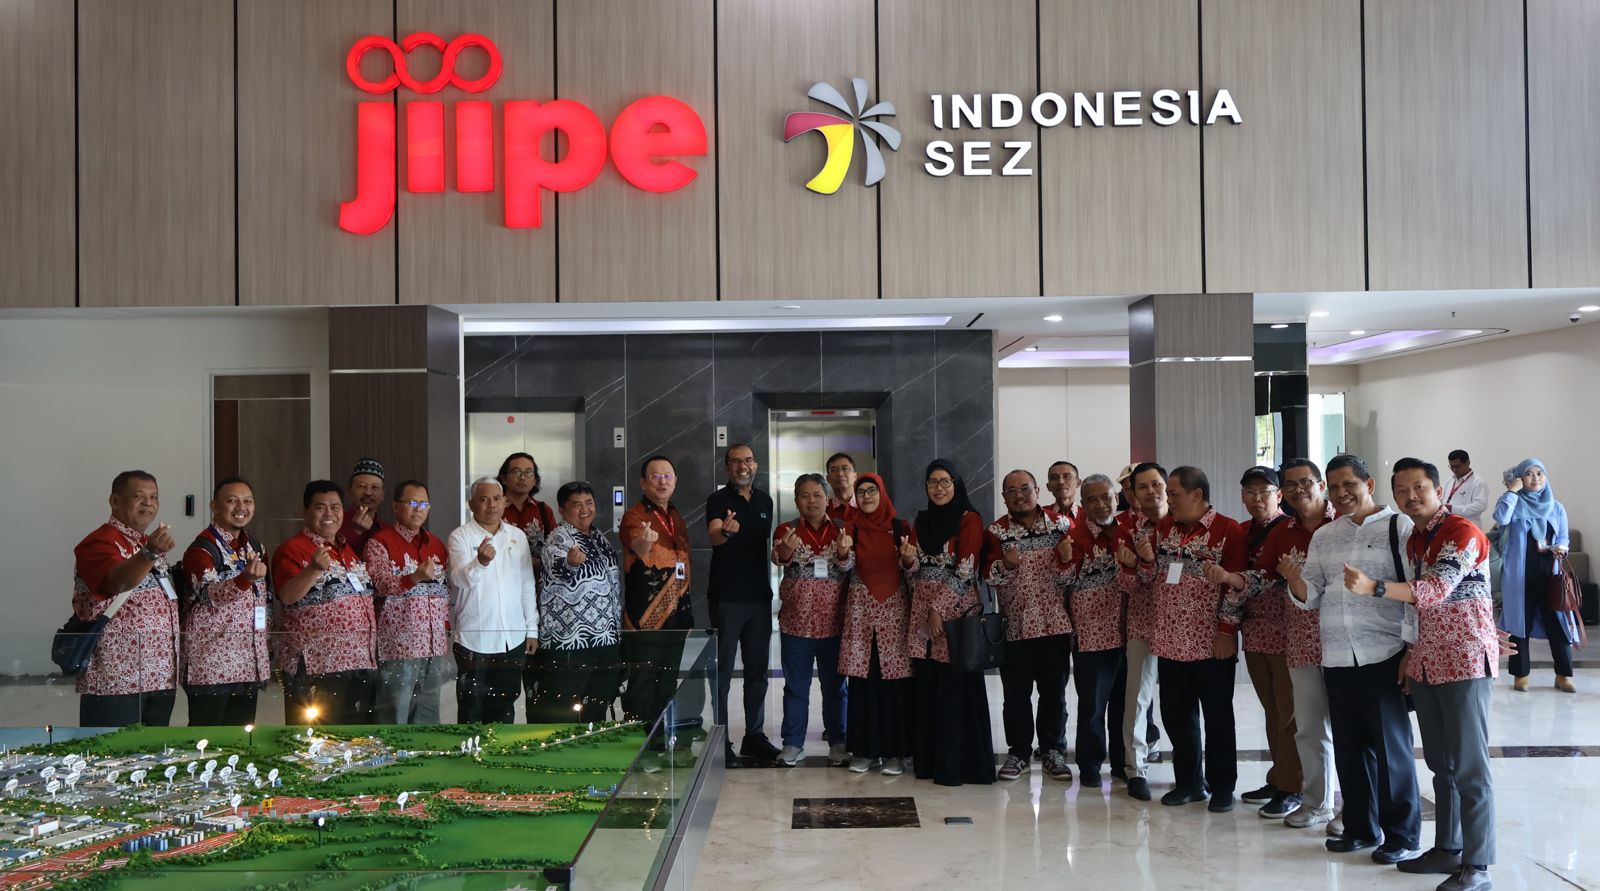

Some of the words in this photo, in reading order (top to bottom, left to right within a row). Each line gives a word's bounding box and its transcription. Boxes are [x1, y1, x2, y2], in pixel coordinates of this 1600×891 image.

[930, 88, 1243, 130] INDONESIA
[338, 32, 708, 235] jiipe
[924, 140, 1033, 177] SEZ
